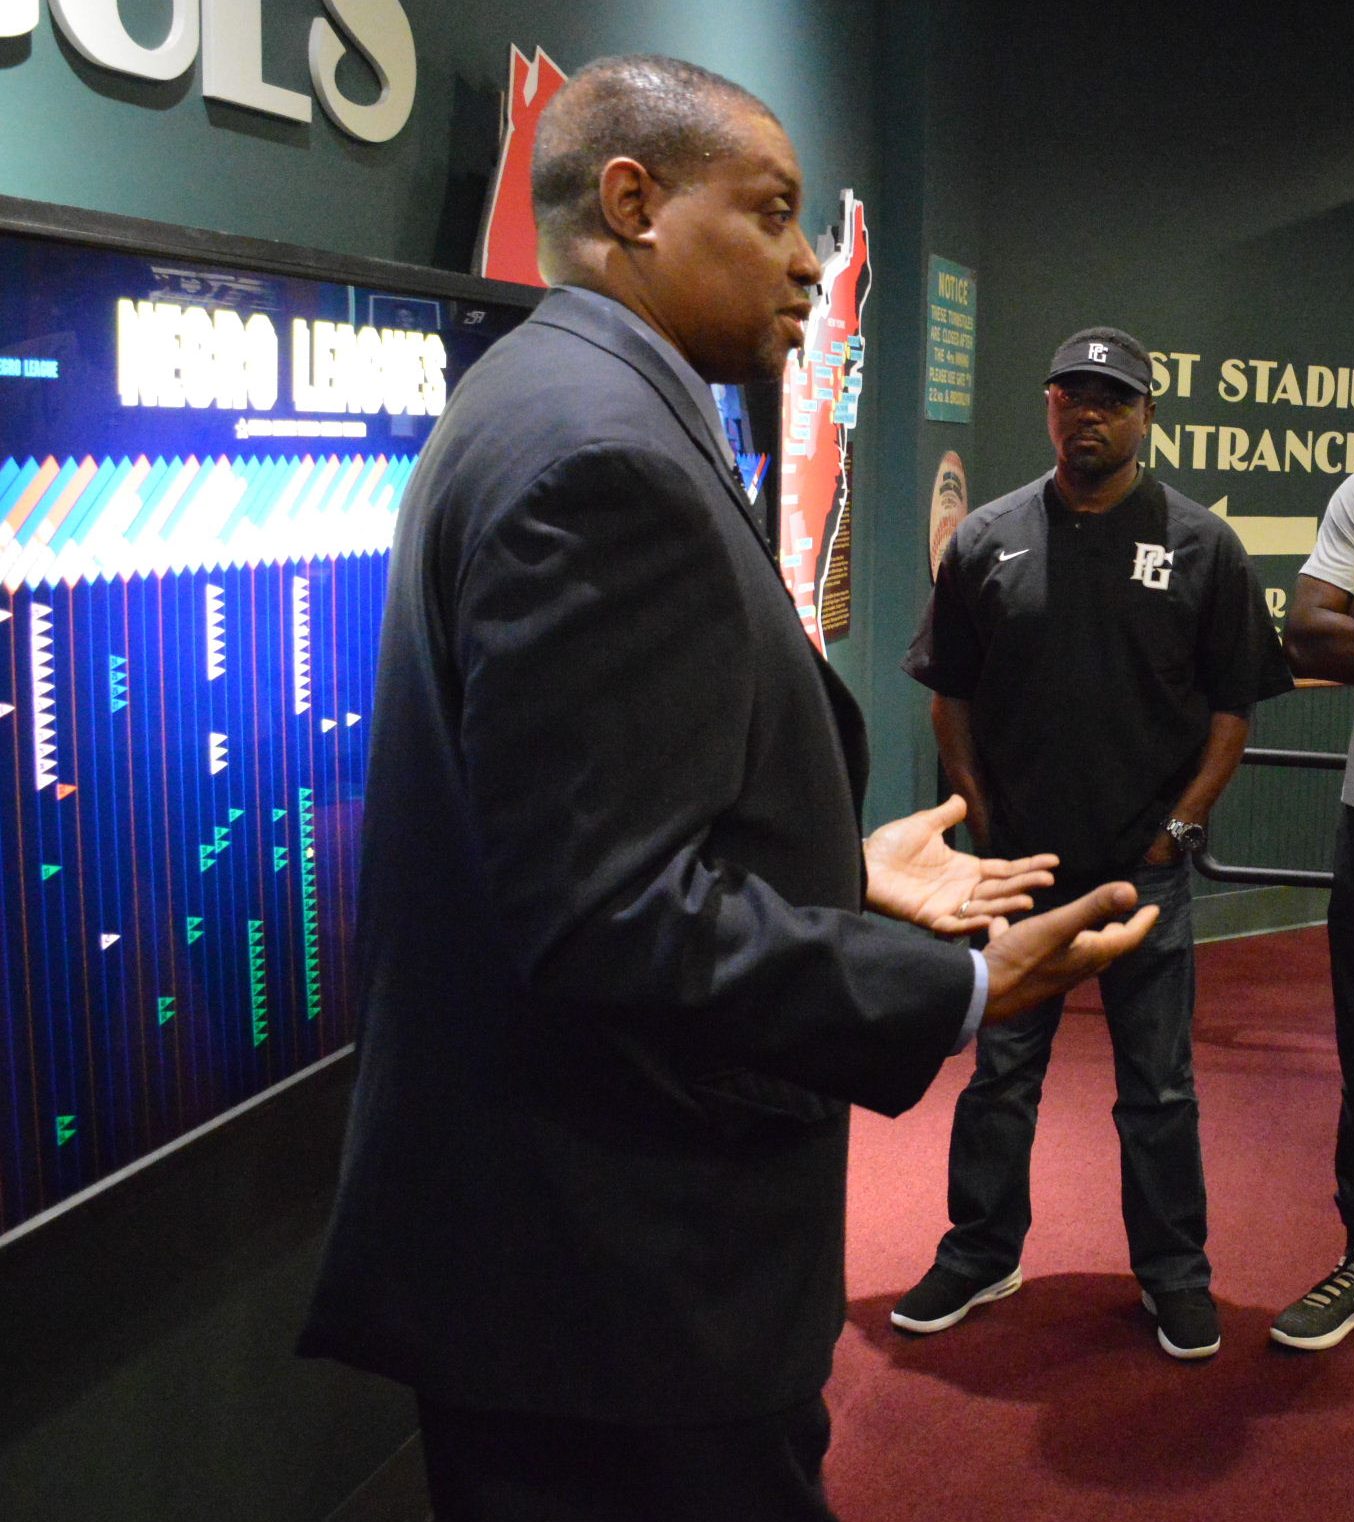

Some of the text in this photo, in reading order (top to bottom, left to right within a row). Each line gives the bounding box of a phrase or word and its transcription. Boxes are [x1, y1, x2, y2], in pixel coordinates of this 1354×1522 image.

[938, 271, 968, 305] NOTICE
[117, 297, 448, 416] NEGRO LEAGUES
[1088, 342, 1108, 363] PG
[1130, 541, 1175, 591] PG
